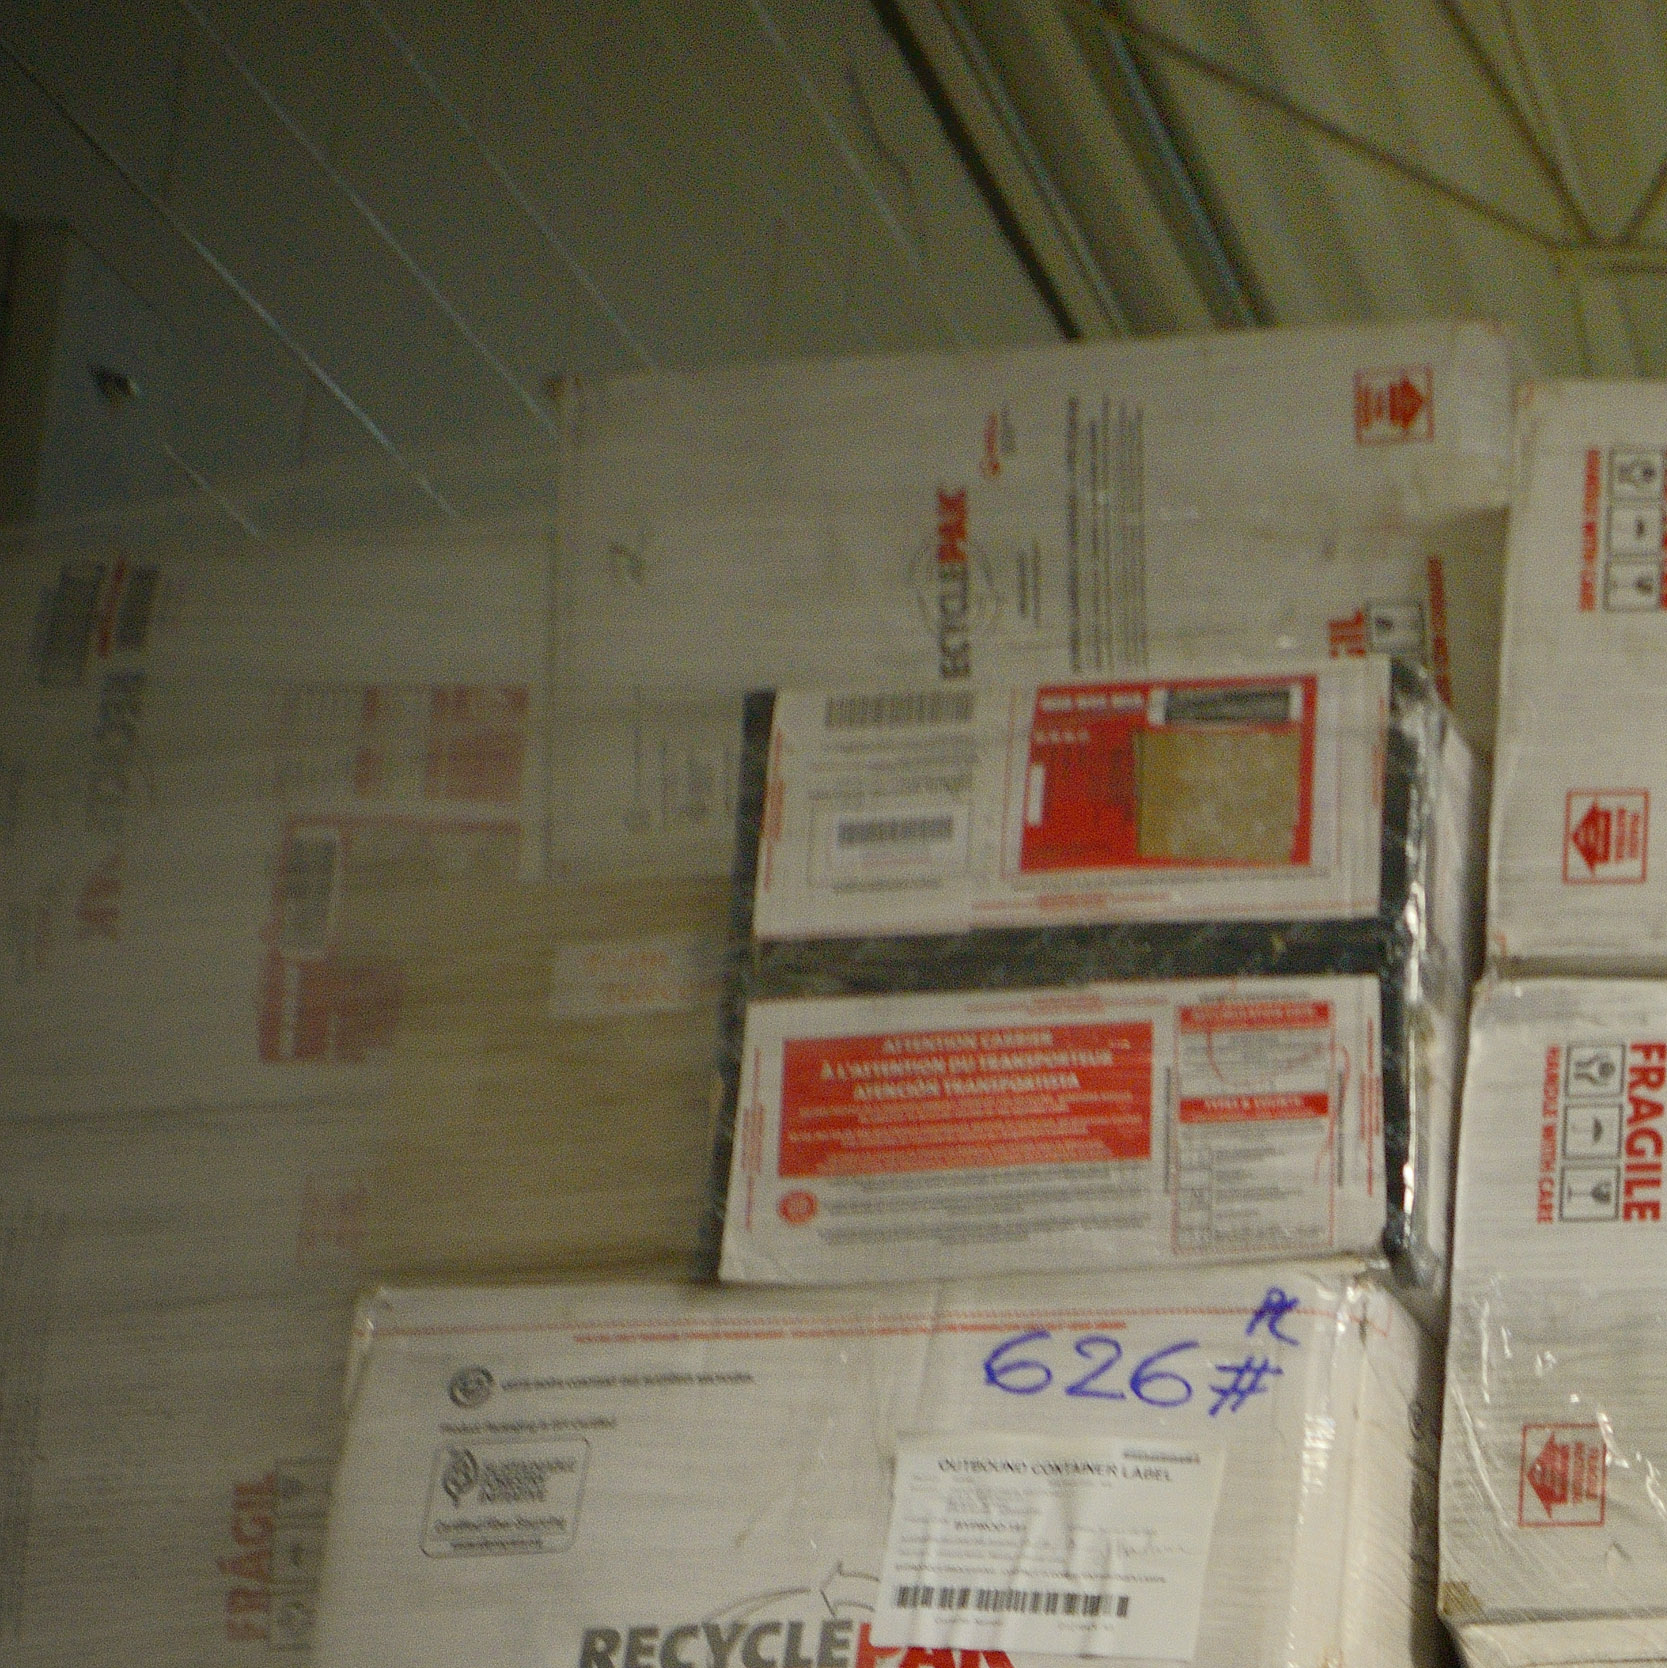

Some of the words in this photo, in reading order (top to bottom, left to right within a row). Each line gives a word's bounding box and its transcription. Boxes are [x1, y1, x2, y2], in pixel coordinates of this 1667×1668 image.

[936, 486, 970, 684] ECYCLEPAK
[1541, 1045, 1560, 1118] HANDLE
[1539, 1122, 1558, 1173] WITH
[1623, 1042, 1667, 1222] FRAGILE
[1537, 1176, 1556, 1225] CARE
